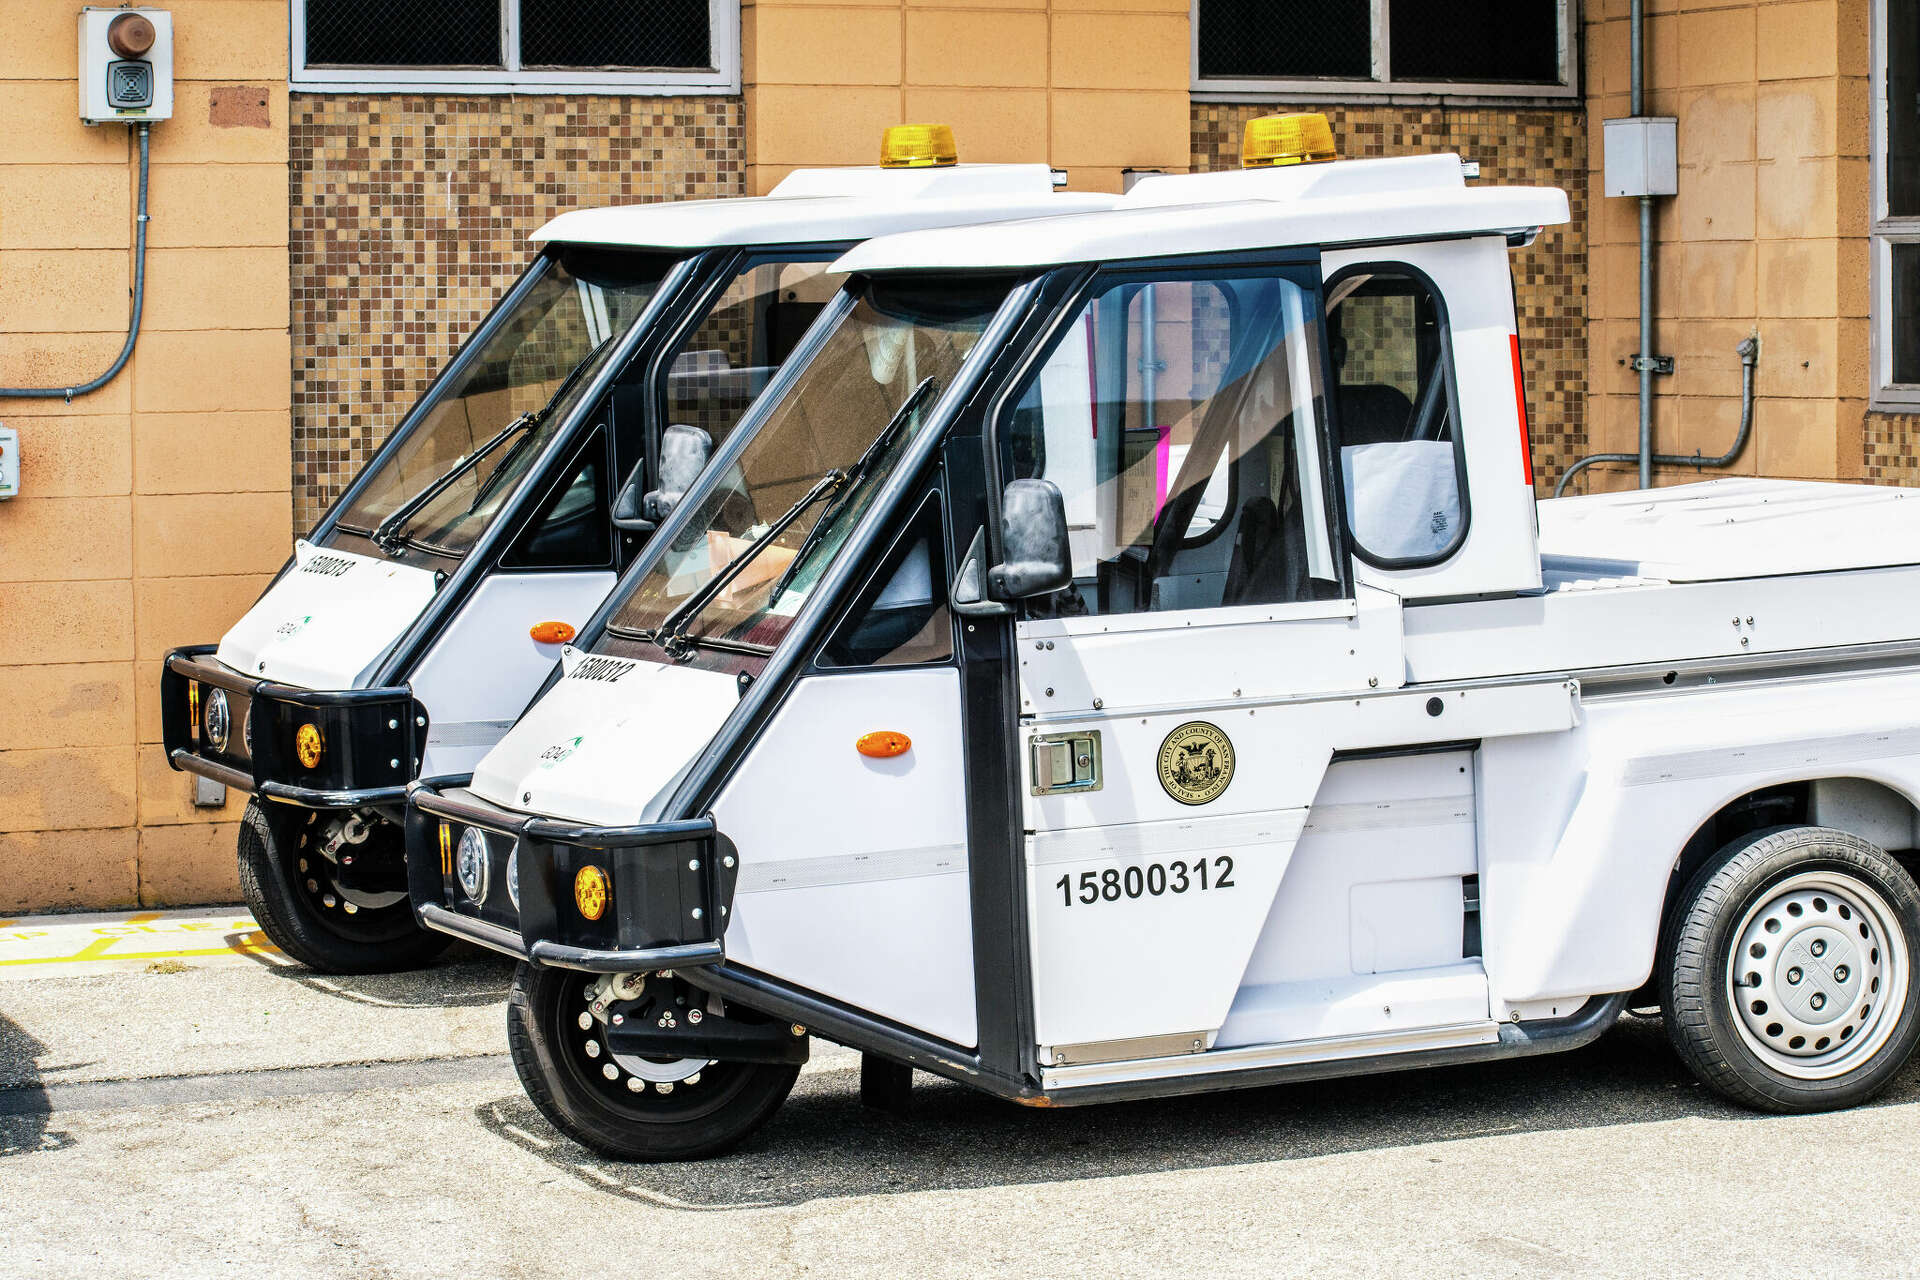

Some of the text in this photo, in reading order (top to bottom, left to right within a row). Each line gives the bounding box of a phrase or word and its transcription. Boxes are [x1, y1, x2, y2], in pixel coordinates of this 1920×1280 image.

[567, 656, 636, 682] 15800312
[1171, 732, 1184, 746] AND
[1185, 727, 1215, 738] COUNTY
[1214, 734, 1224, 743] OF
[1163, 746, 1173, 763] CITY
[1222, 743, 1230, 759] SAN
[1177, 788, 1194, 799] SEAL
[1056, 855, 1235, 907] 15800312
